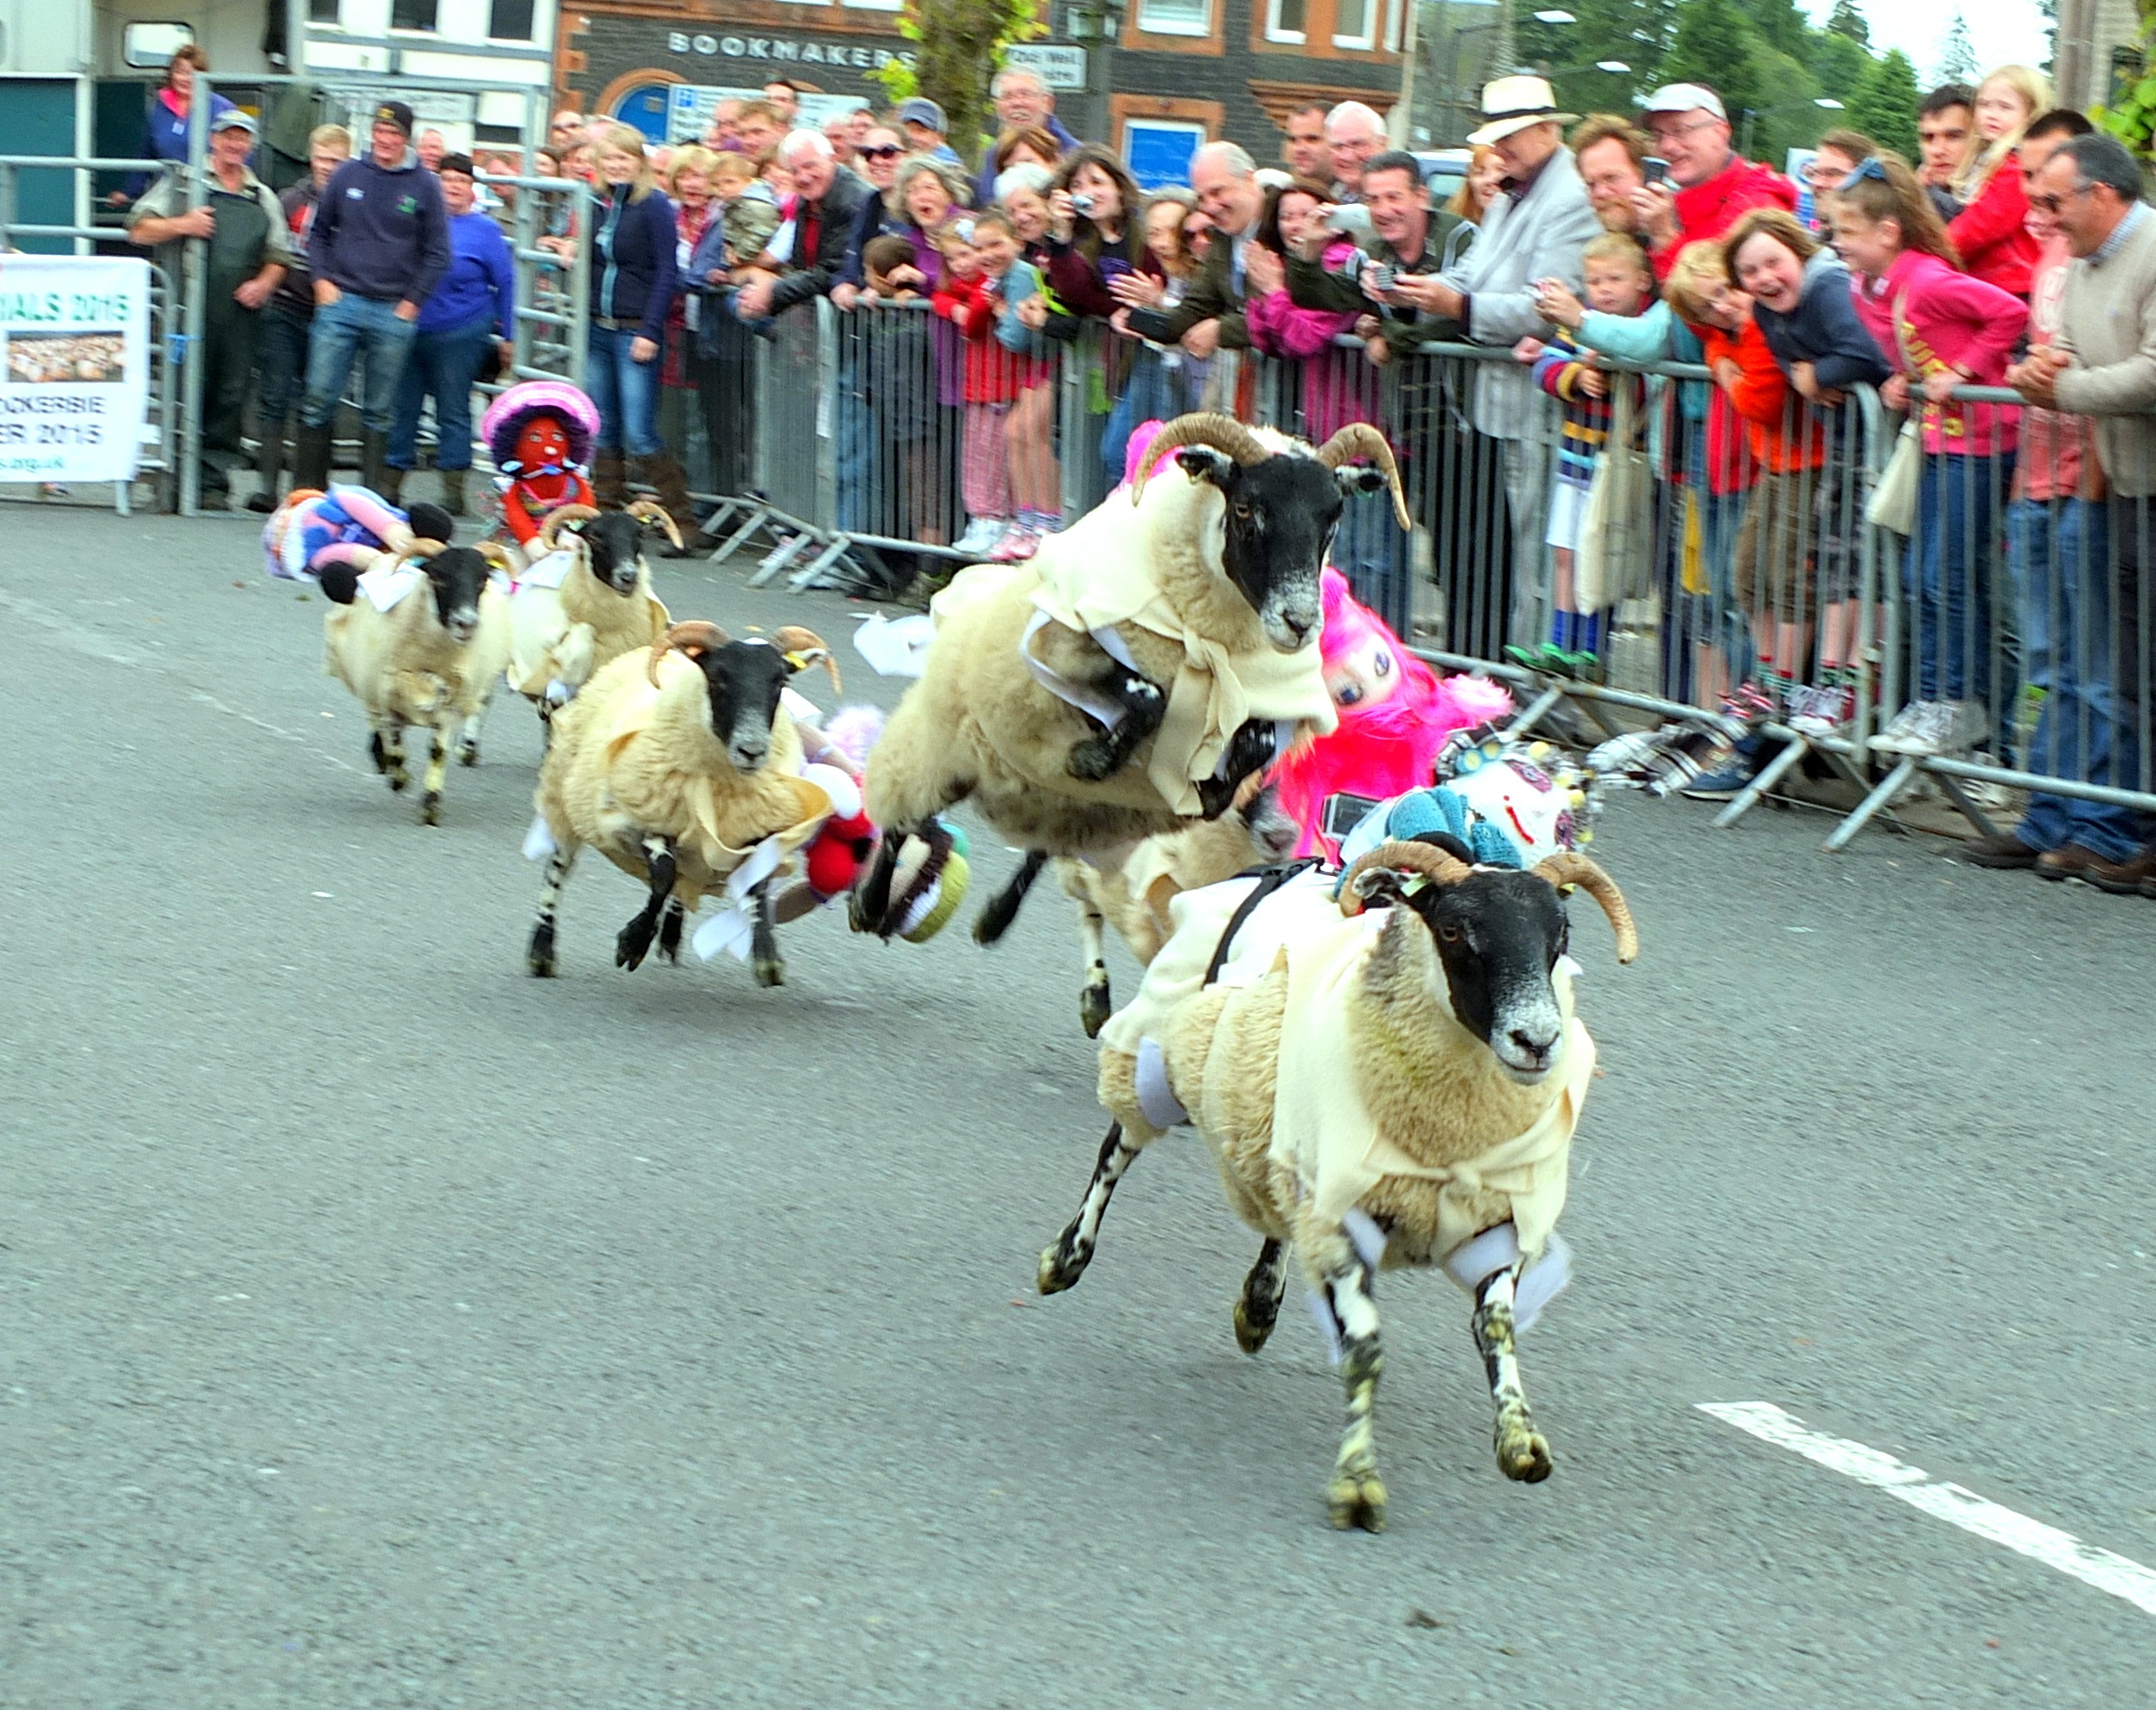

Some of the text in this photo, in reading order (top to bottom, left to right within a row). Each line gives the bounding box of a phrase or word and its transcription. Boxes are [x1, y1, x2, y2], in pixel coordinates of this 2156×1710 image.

[668, 32, 917, 71] BOOKMAKERS
[71, 293, 128, 321] 2015
[37, 423, 102, 444] 2015
